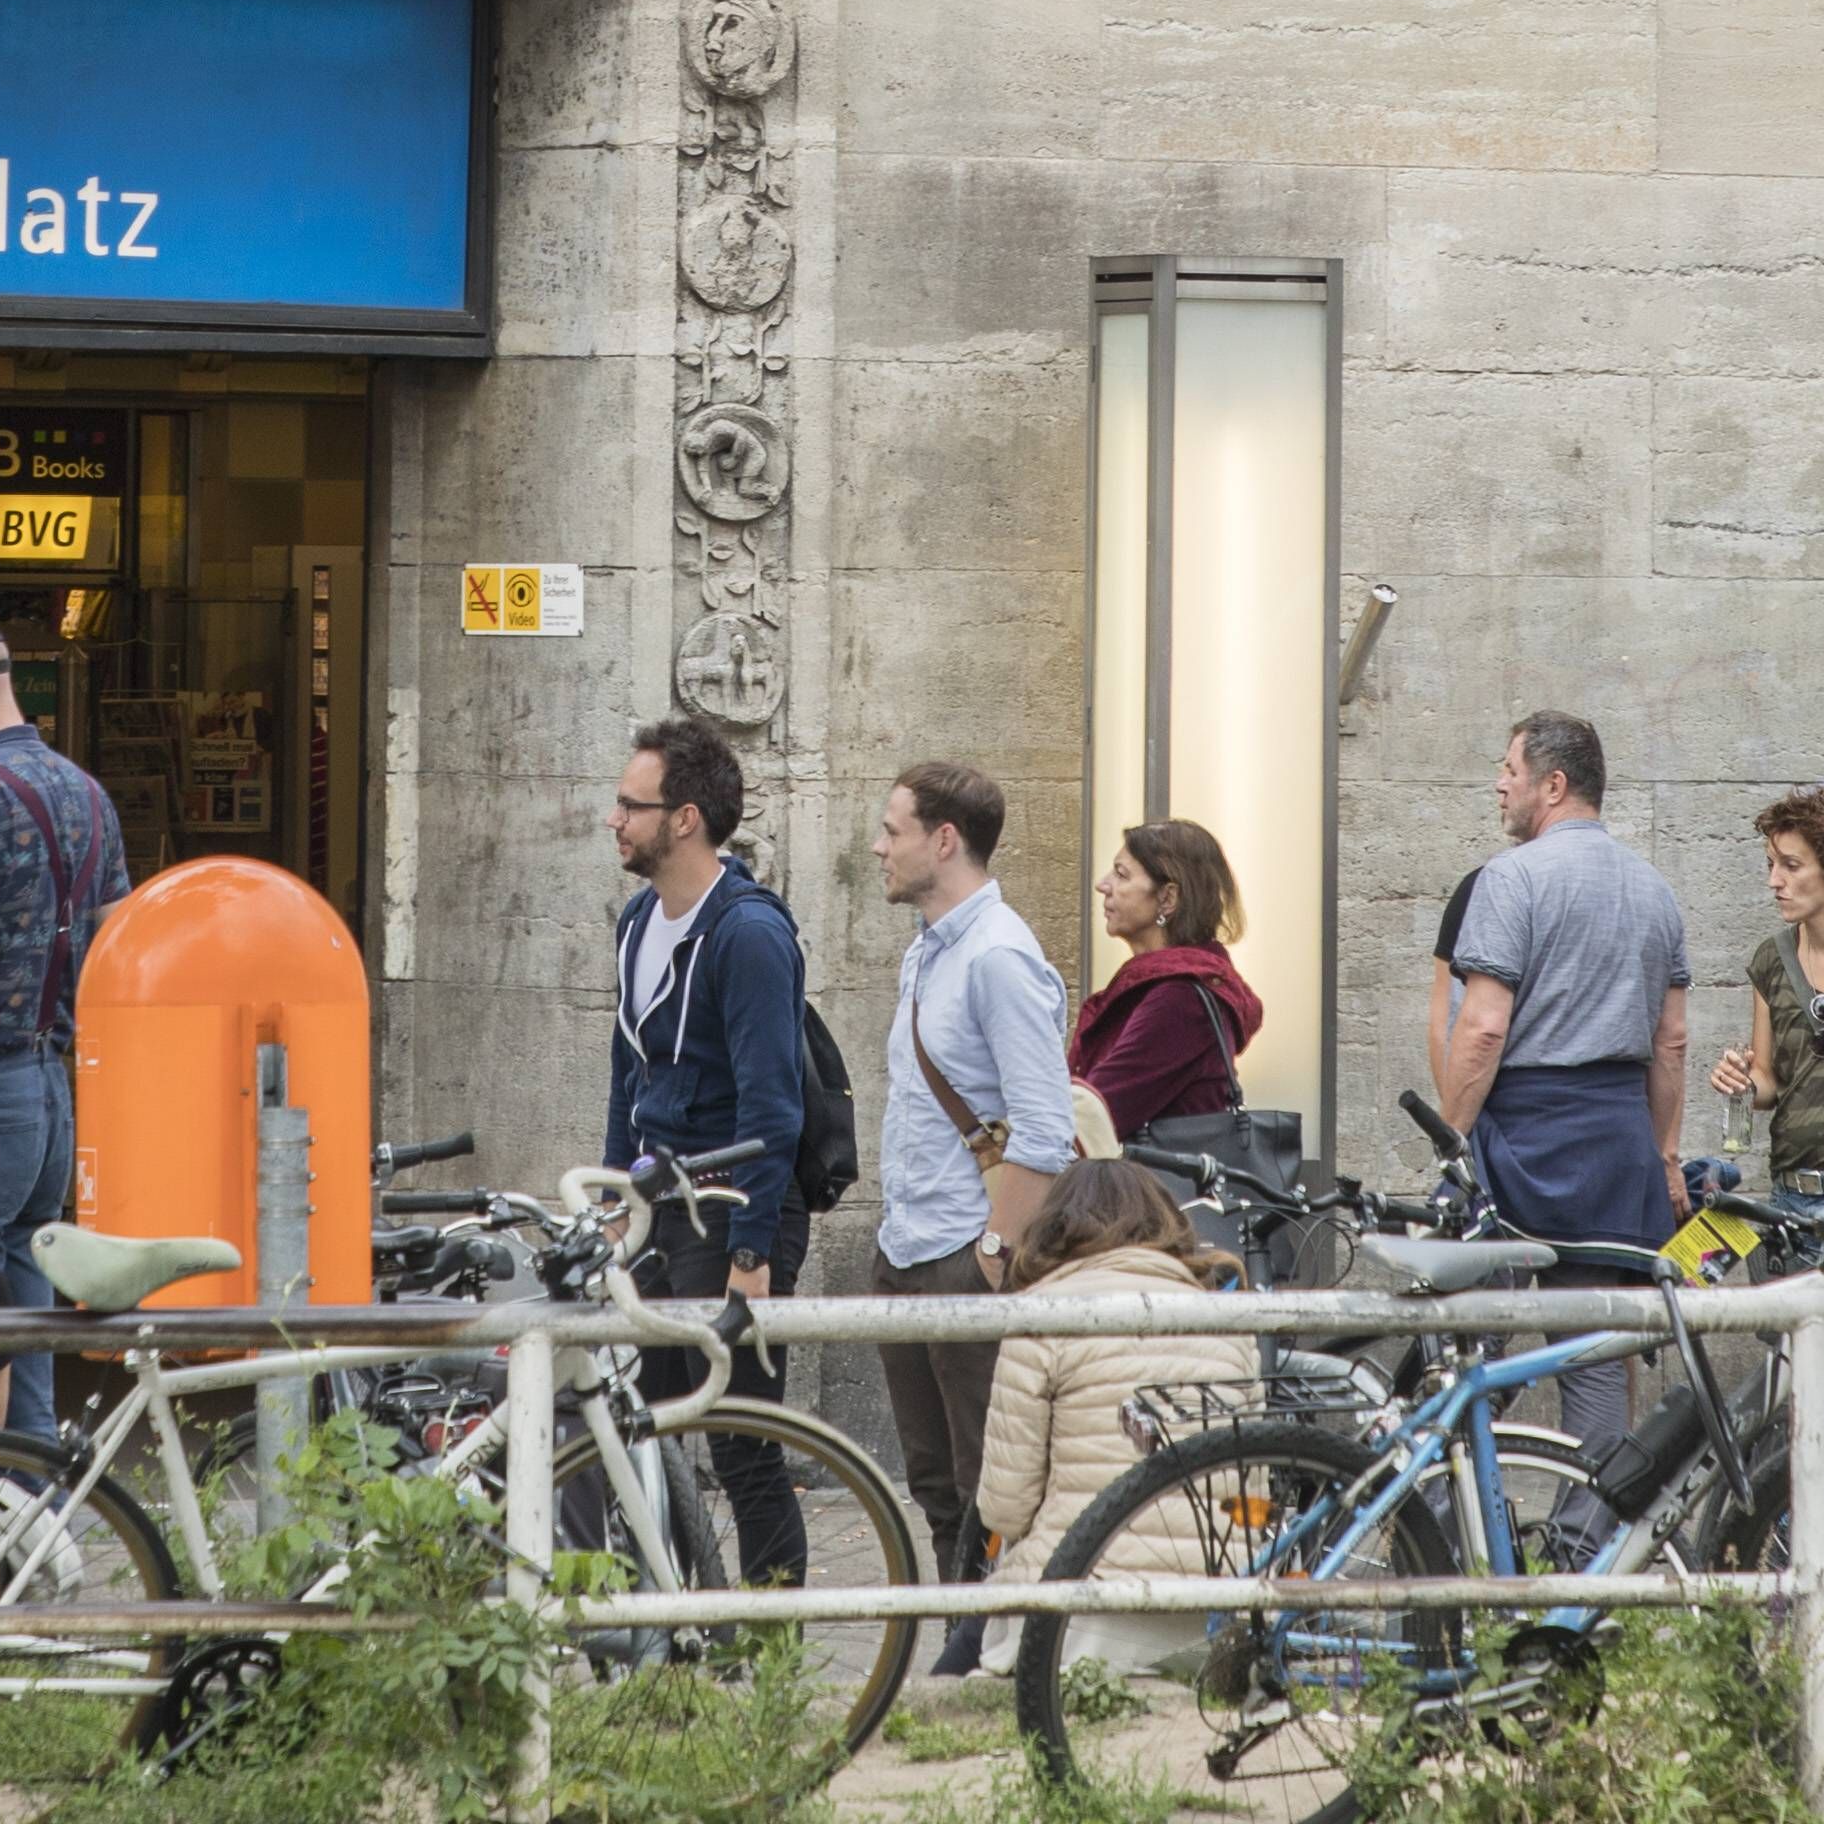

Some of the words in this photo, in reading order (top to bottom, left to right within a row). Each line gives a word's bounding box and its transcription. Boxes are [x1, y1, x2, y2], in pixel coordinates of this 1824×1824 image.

[32, 455, 106, 479] Books
[1, 510, 77, 547] BVG
[508, 613, 535, 627] Video
